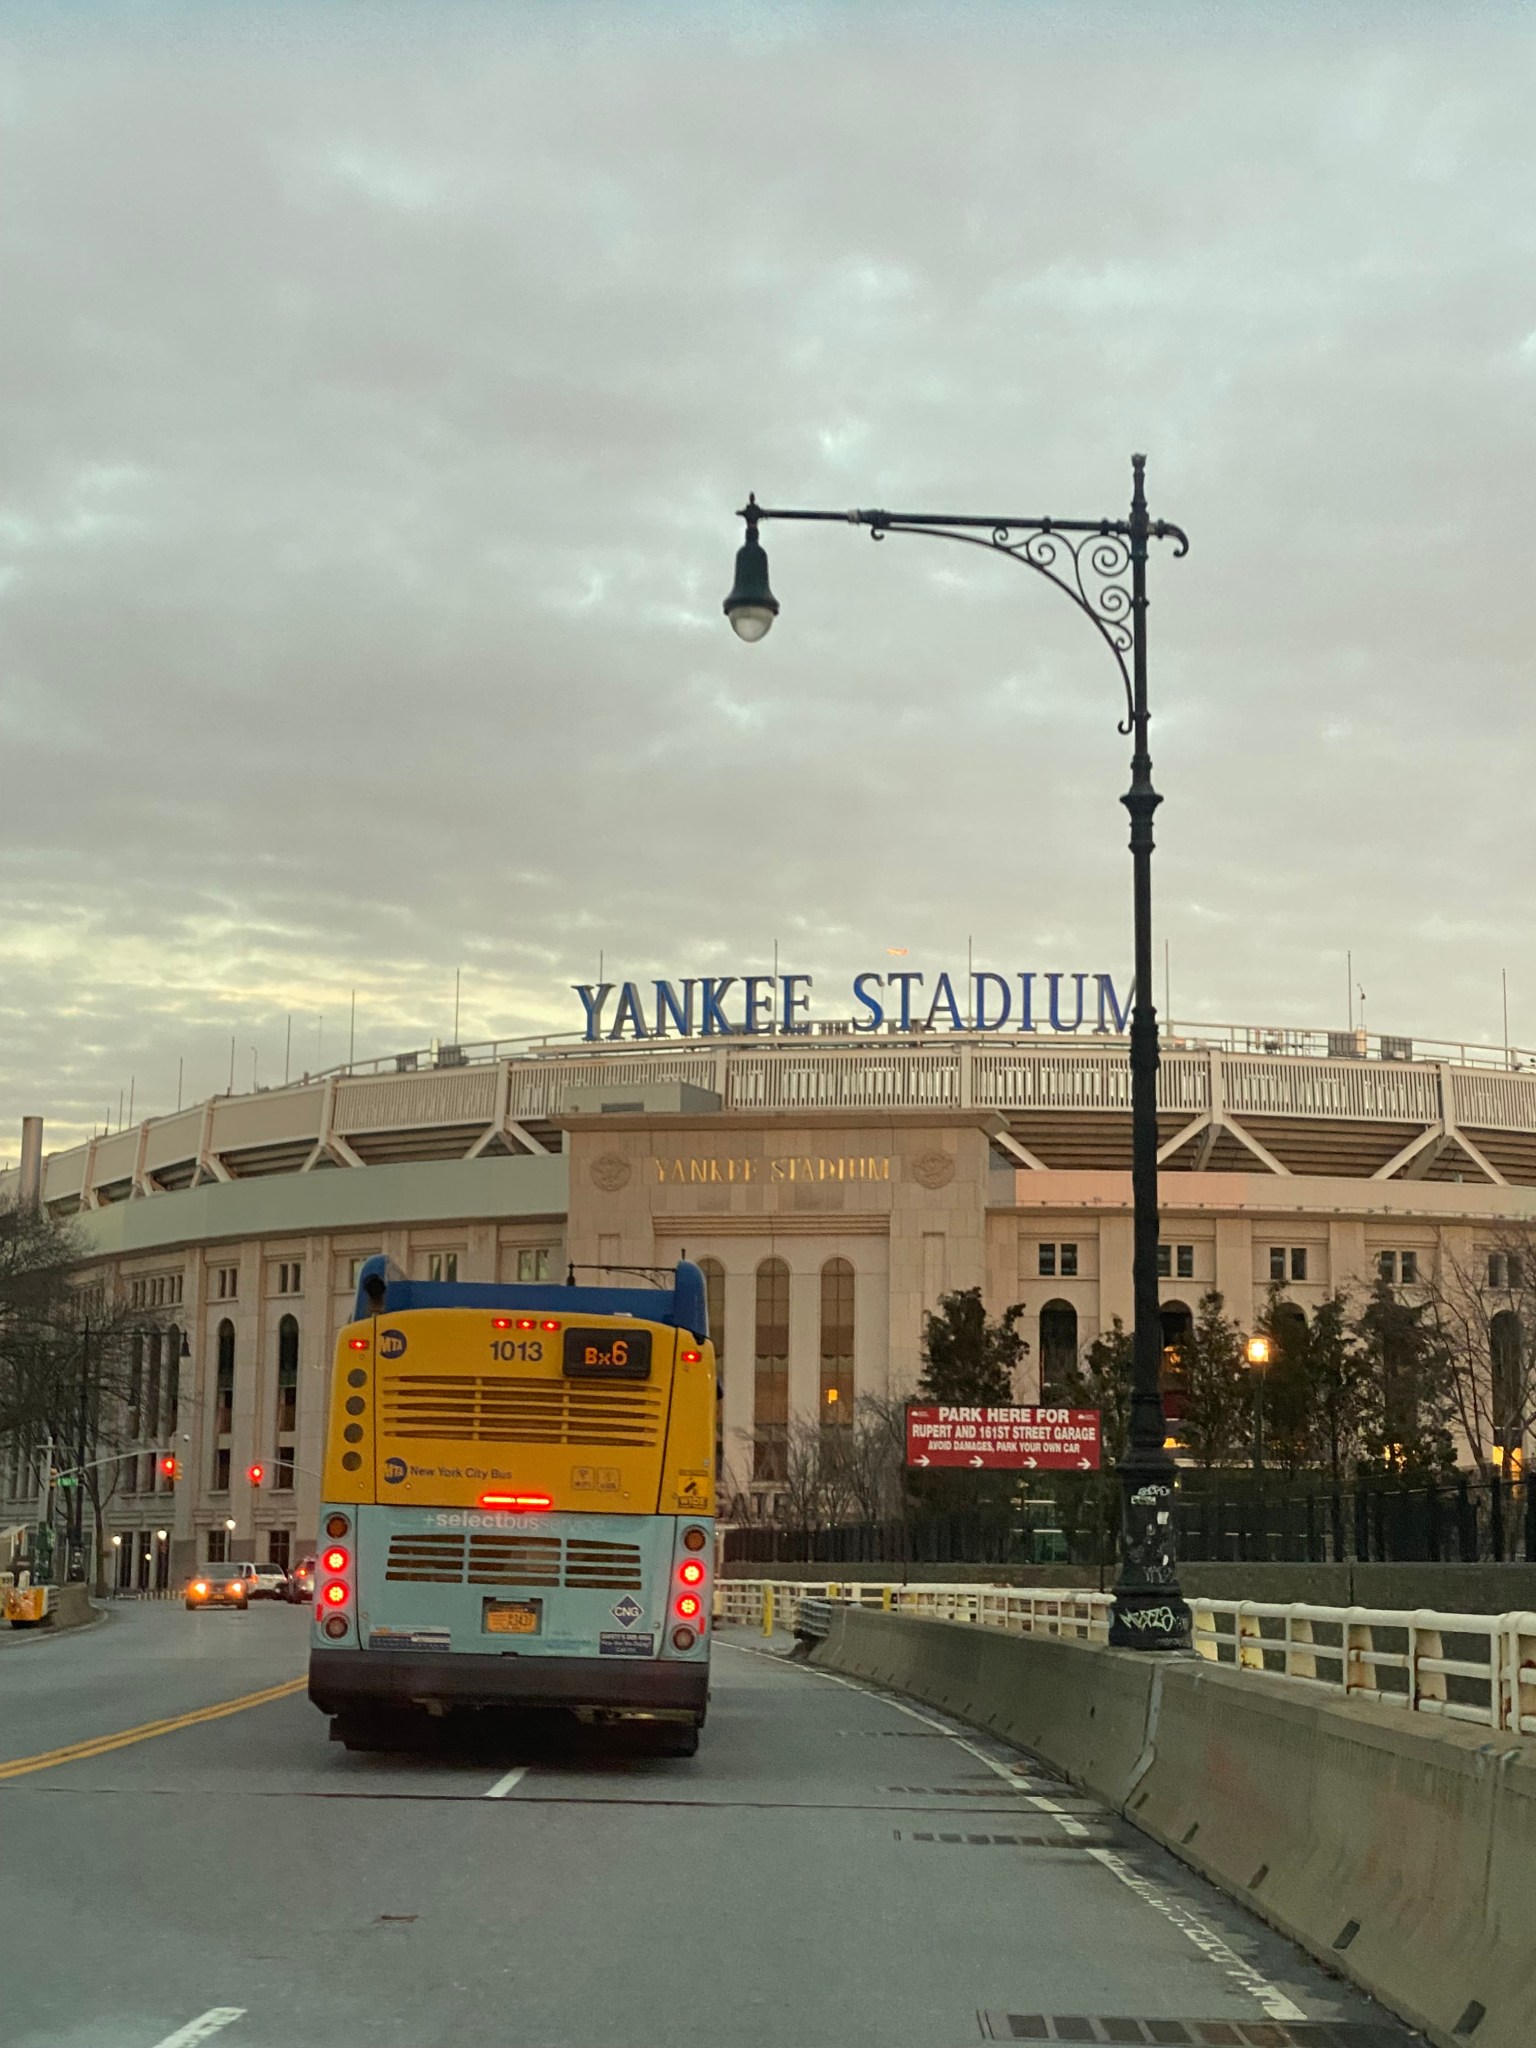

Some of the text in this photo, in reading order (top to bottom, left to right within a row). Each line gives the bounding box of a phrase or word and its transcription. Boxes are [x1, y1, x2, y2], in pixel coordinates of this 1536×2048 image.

[571, 972, 1136, 1041] YANKEE STADIUM
[656, 1158, 890, 1182] YANKEE STADIUM
[380, 1334, 405, 1355] MTA
[489, 1340, 543, 1361] 1013
[584, 1340, 629, 1365] Bx6
[939, 1406, 982, 1422] PARK
[987, 1408, 1031, 1423] HERE
[1036, 1408, 1069, 1423] FOR
[912, 1424, 1096, 1441] RUPERT AND 161ST STREET GARAGE
[928, 1440, 1080, 1453] AVOID DAMAGES, PARK YOUR OWN CAR
[410, 1465, 512, 1479] New York City Bus
[614, 1606, 639, 1617] CNG
